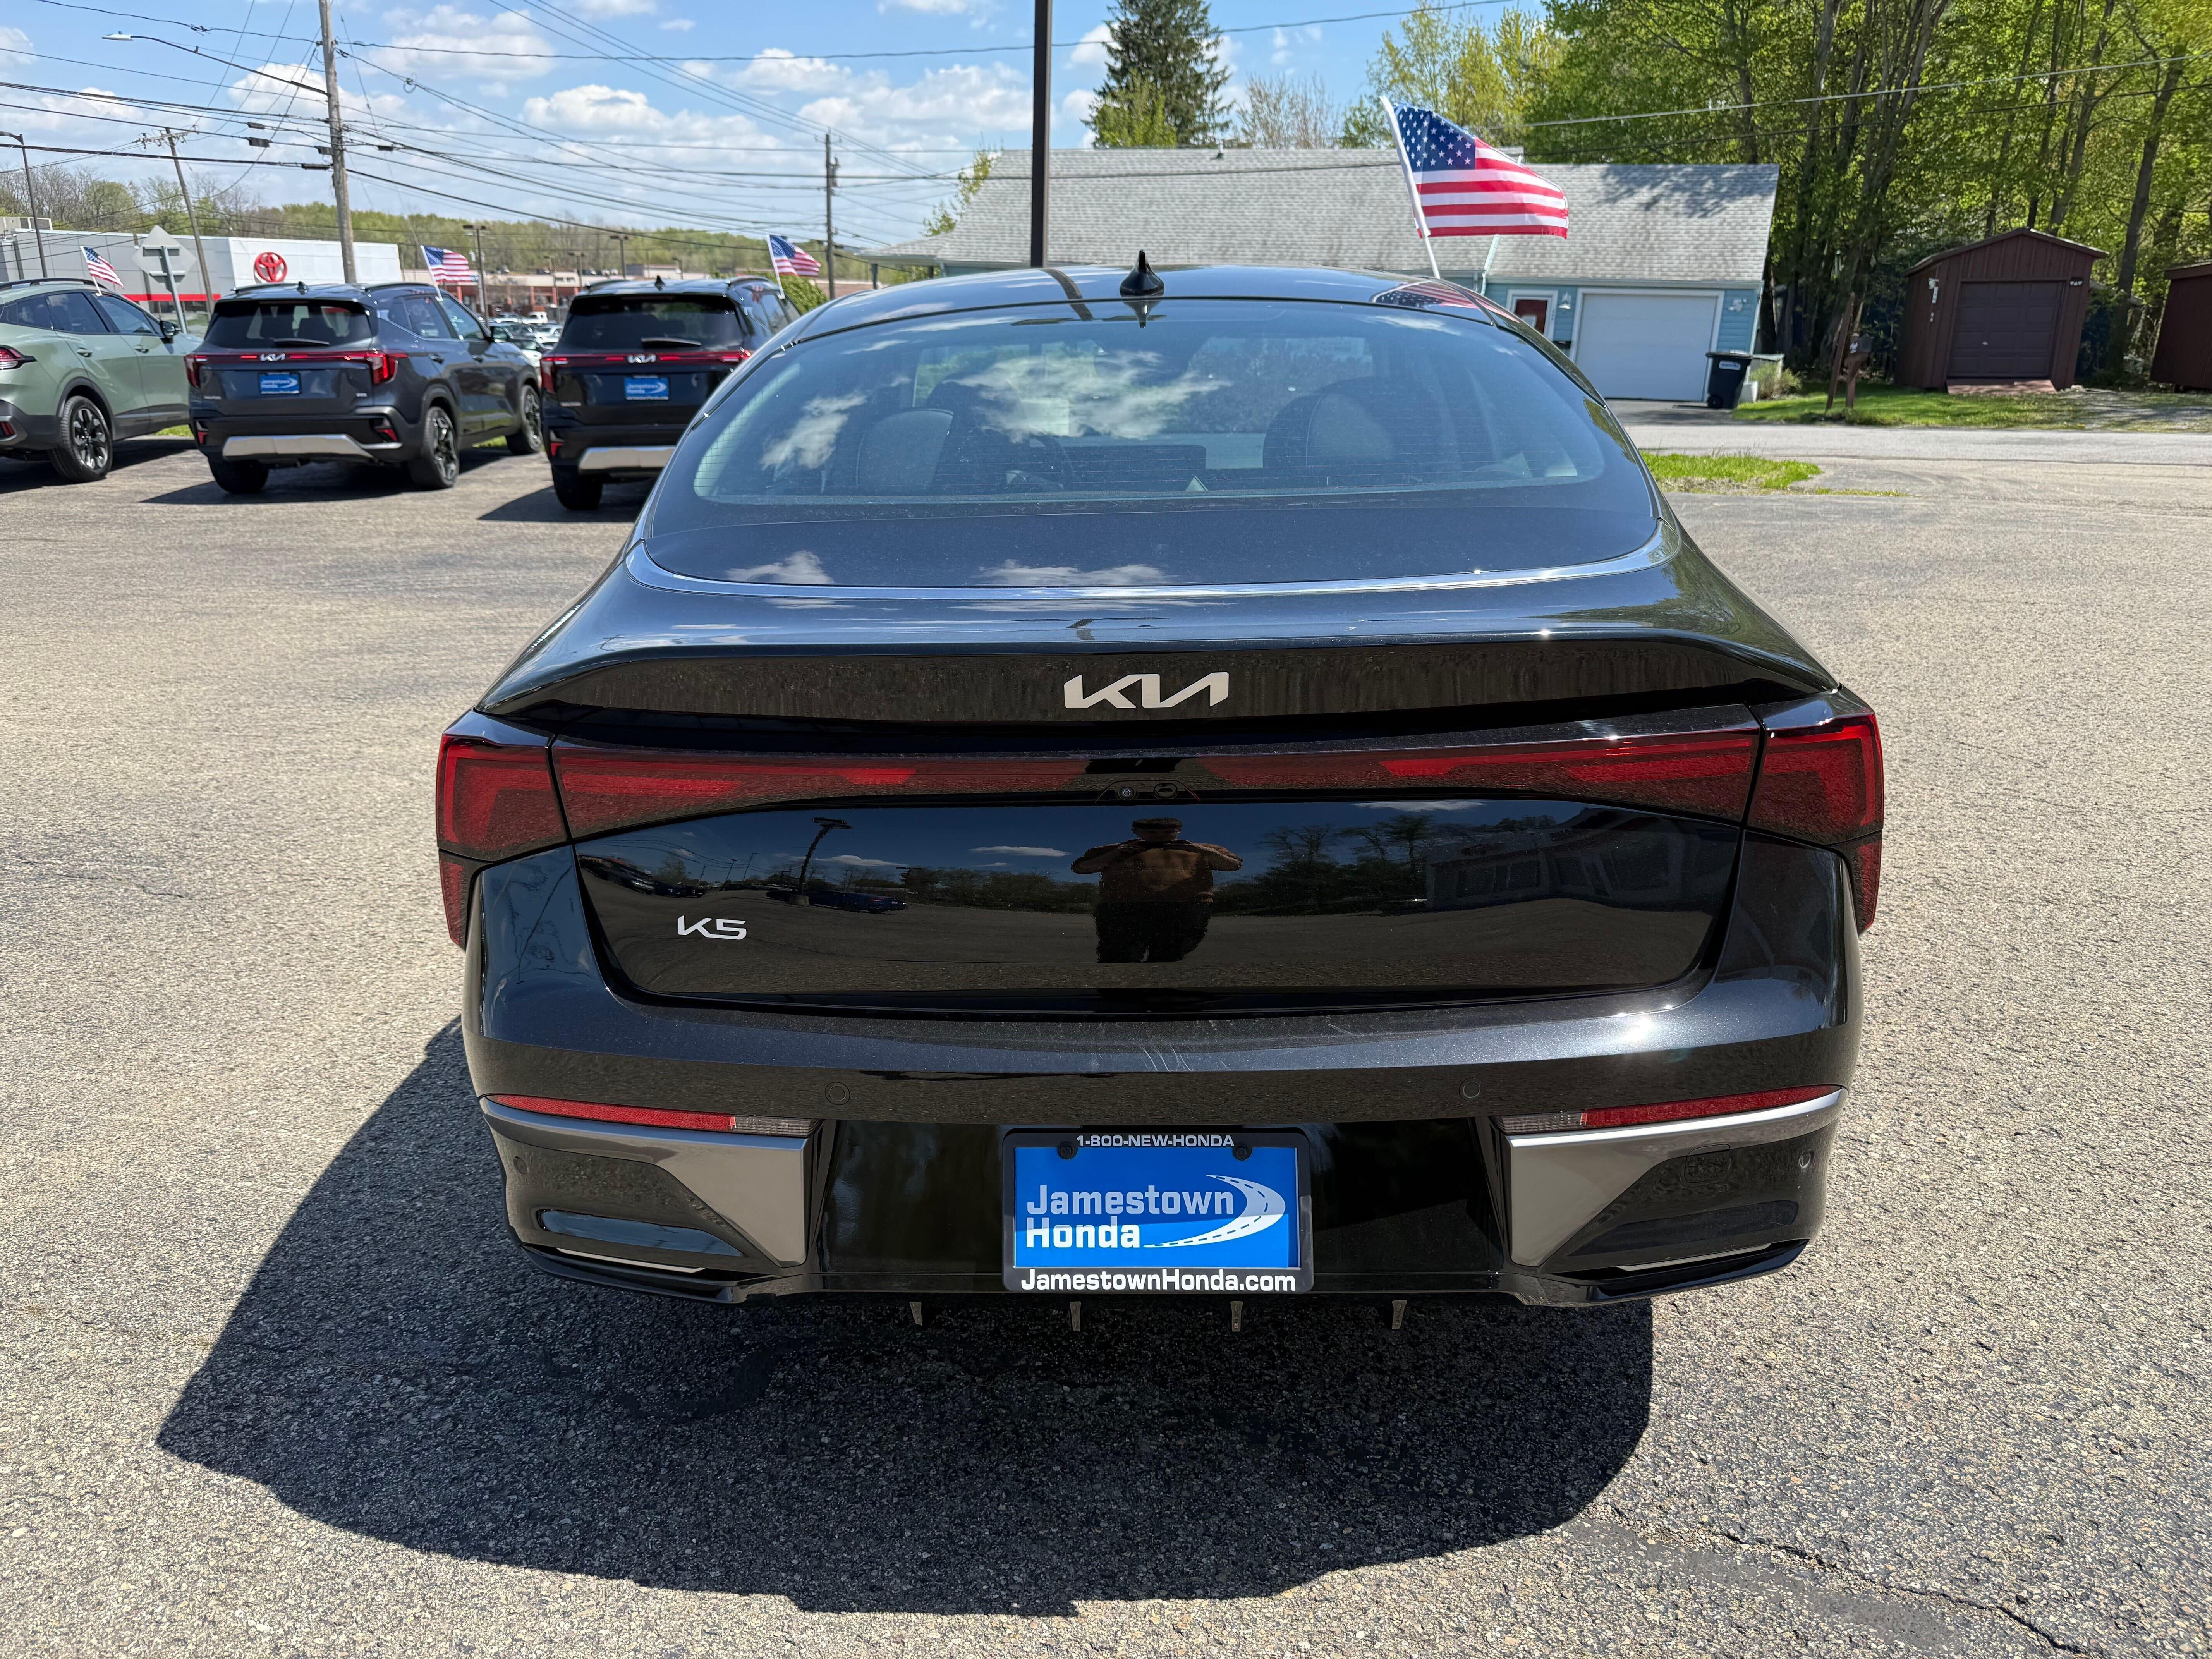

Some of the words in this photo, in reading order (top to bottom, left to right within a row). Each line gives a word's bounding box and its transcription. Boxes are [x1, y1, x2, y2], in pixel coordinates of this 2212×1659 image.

[1064, 672, 1229, 709] KIA
[678, 915, 747, 940] K5
[1077, 1135, 1234, 1147] 1-800-NEW-HONDA
[1027, 1185, 1233, 1214] Jamestown
[1026, 1216, 1140, 1248] Honda
[1021, 1269, 1296, 1291] JamestownHonda.com
